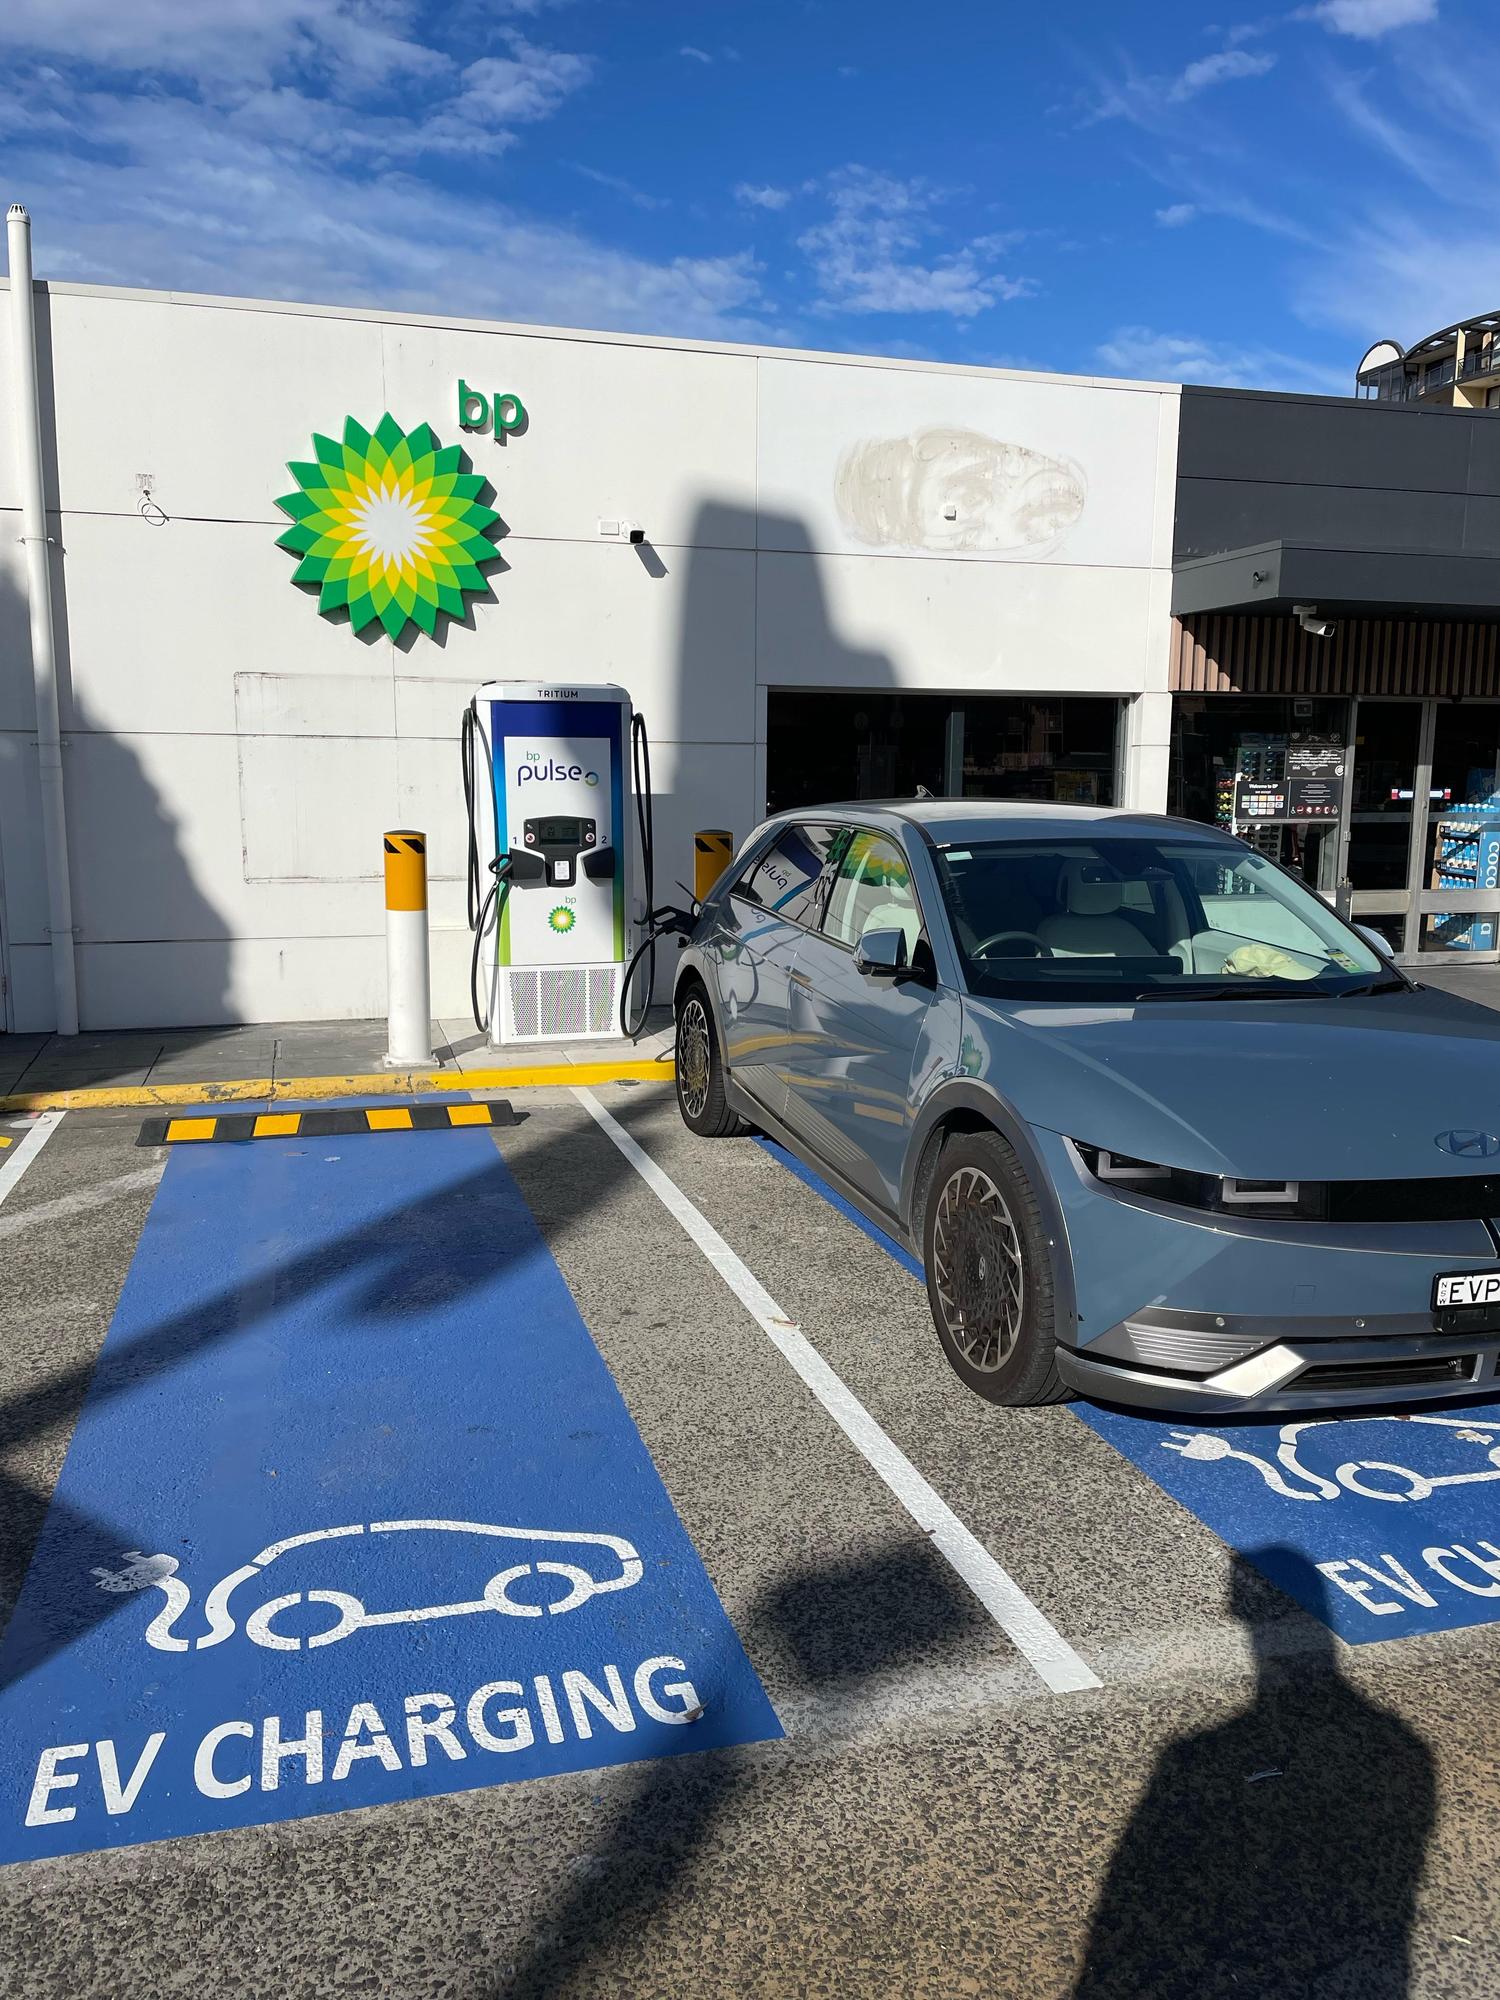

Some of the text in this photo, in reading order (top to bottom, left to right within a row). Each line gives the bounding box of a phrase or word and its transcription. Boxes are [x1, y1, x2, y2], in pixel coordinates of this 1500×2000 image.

[458, 379, 523, 440] bp
[537, 689, 579, 698] TRITIUM
[526, 750, 541, 762] bp
[517, 758, 583, 787] pulse
[601, 835, 608, 845] 2
[565, 895, 577, 905] bp
[1449, 1278, 1500, 1304] EVP
[1314, 1553, 1439, 1615] EV
[25, 1656, 705, 1827] EV CHARGING
